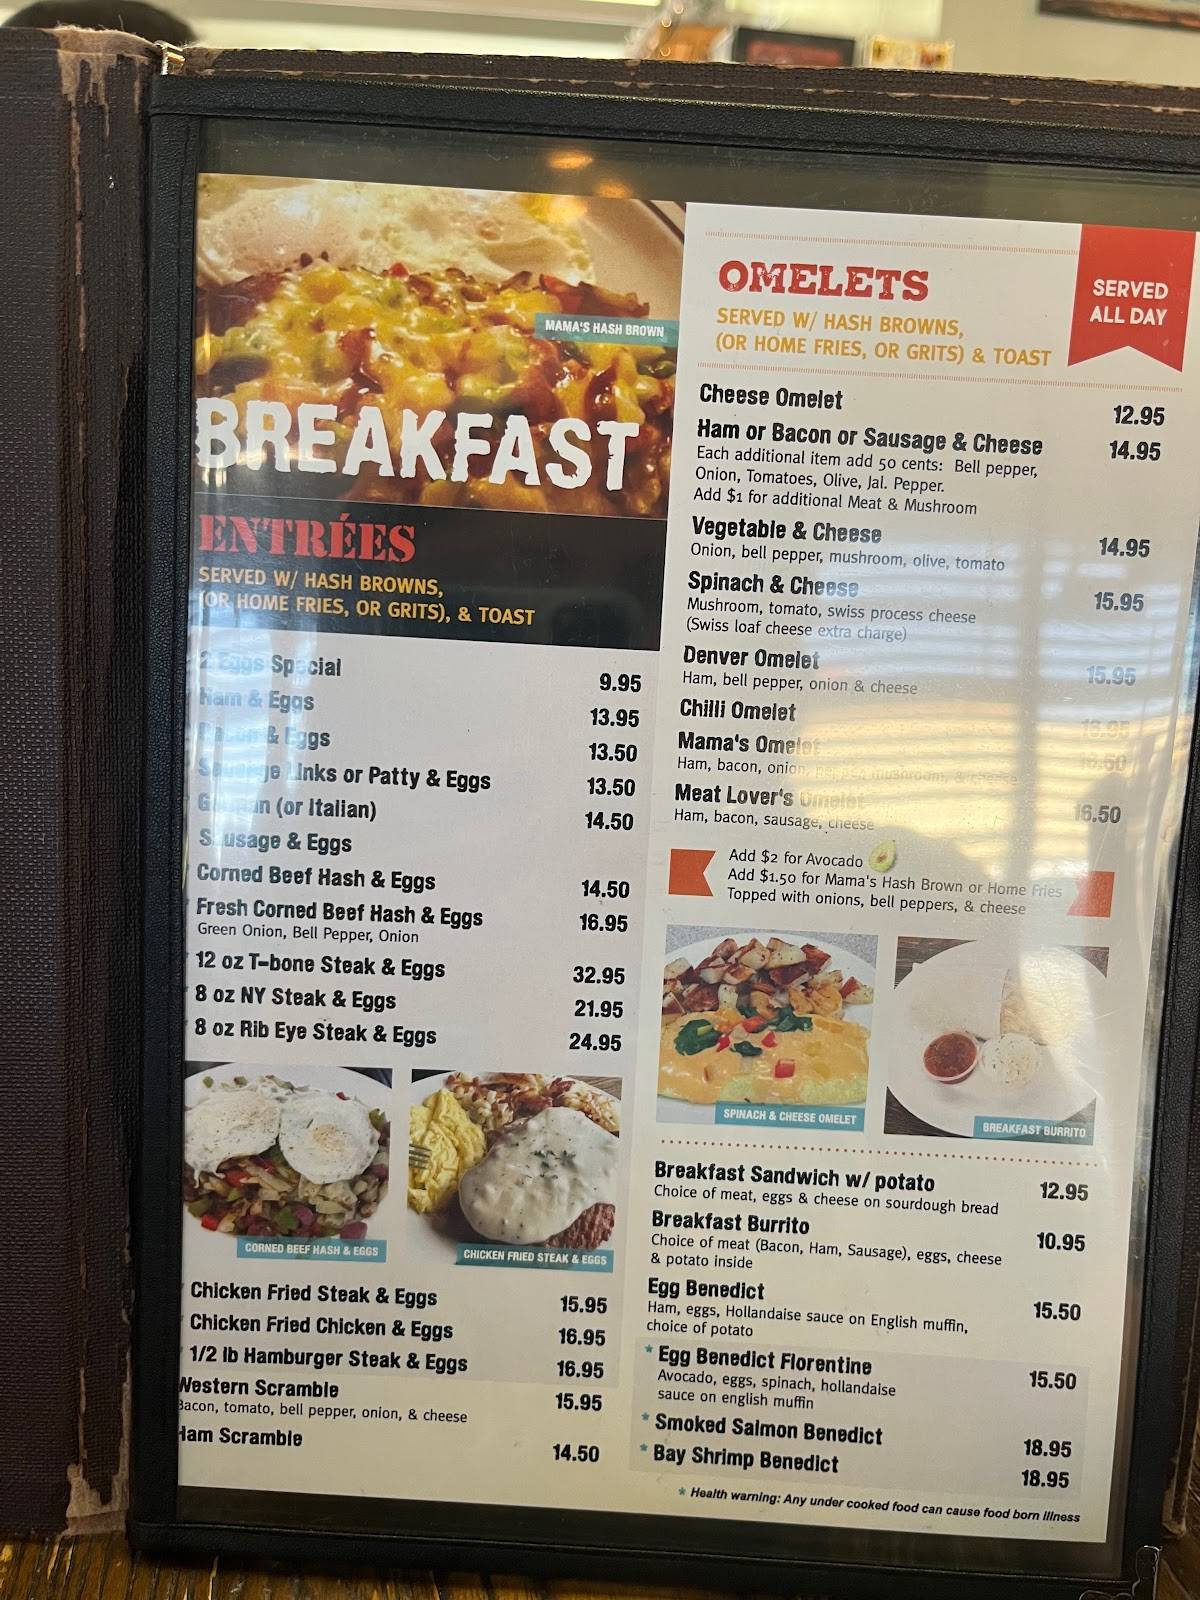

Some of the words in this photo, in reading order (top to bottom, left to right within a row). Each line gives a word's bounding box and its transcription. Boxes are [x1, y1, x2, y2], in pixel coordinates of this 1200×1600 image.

[719, 260, 928, 300] OMELETS
[1093, 279, 1168, 299] SERVED
[717, 307, 785, 328] SERVED
[793, 311, 817, 331] W/
[824, 313, 872, 331] HASH
[880, 316, 963, 339] BROWNS,
[1090, 305, 1124, 323] ALL
[1130, 307, 1167, 325] DAY
[545, 320, 590, 333] MAMA'S
[593, 322, 622, 334] HASH
[626, 324, 664, 337] BROWN
[716, 332, 746, 352] (OR
[754, 335, 806, 353] HOME
[814, 339, 866, 359] FRIES,
[874, 342, 899, 358] OR
[907, 344, 964, 365] GRITS)
[972, 348, 985, 363] &
[993, 348, 1052, 366] TOAST
[700, 383, 769, 405] Cheese
[776, 387, 842, 409] Omelet
[1113, 405, 1164, 425] 12.95
[195, 397, 639, 492] BREAKFAST
[697, 418, 739, 439] Ham
[746, 425, 766, 440] or
[772, 422, 831, 443] Bacon
[837, 430, 857, 445] or
[863, 427, 946, 453] Sausage
[952, 432, 967, 451] &
[973, 433, 1042, 455] Cheese
[1110, 440, 1160, 461] 14.95
[199, 512, 417, 563] ENTRÉES
[692, 516, 786, 540] Vegetable
[792, 521, 806, 539] &
[813, 522, 881, 542] Cheese
[1099, 537, 1149, 557] 14.95
[198, 567, 265, 584] SERVED
[274, 570, 297, 589] W/
[305, 572, 352, 589] HASH
[360, 575, 443, 598] BROWNS,
[600, 673, 641, 692] 9.95
[590, 708, 639, 727] 13.95
[680, 698, 725, 717] Chilli
[731, 701, 795, 721] Omelet
[589, 742, 637, 762] 13.50
[587, 777, 635, 796] 13.50
[585, 811, 633, 830] 14.50
[729, 848, 755, 861] Add
[761, 849, 777, 864] $2
[784, 851, 802, 864] for
[806, 852, 862, 867] Avocado
[197, 863, 262, 882] Corned
[269, 866, 312, 884] Beef
[318, 868, 364, 887] Hash
[371, 870, 385, 887] &
[391, 871, 435, 893] Eggs
[582, 880, 629, 898] 14.50
[196, 897, 247, 916] Fresh
[253, 900, 316, 918] Corned
[323, 902, 364, 921] Beef
[370, 904, 415, 923] Hash
[421, 906, 434, 924] &
[440, 907, 482, 929] Eggs
[579, 913, 627, 932] 16.95
[198, 922, 236, 935] Green
[242, 924, 286, 939] Onion,
[293, 926, 317, 938] Bell
[323, 927, 372, 943] Pepper,
[379, 929, 418, 942] Onion
[195, 951, 215, 968] 12
[222, 955, 243, 969] oz
[248, 953, 314, 972] T-bone
[320, 956, 375, 974] Steak
[381, 958, 395, 975] &
[401, 959, 444, 981] Eggs
[573, 966, 624, 984] 32.95
[195, 1018, 206, 1035] 8
[213, 1022, 234, 1036] oz
[240, 1020, 269, 1037] Rib
[275, 1021, 306, 1042] Eye
[312, 1023, 367, 1041] Steak
[373, 1025, 387, 1042] &
[393, 1026, 436, 1047] Eggs
[569, 1033, 621, 1051] 24.95
[723, 1108, 766, 1119] SPINACH
[769, 1111, 776, 1120] &
[779, 1111, 816, 1122] CHEESE
[818, 1113, 856, 1124] OMELET
[983, 1122, 1042, 1134] BREAKFAST
[1044, 1125, 1085, 1137] BURRITO
[655, 1161, 745, 1181] Breakfast
[750, 1165, 839, 1186] Sandwich
[845, 1171, 870, 1187] w/
[875, 1173, 934, 1192] potato
[1040, 1182, 1088, 1201] 12.95
[652, 1210, 741, 1230] Breakfast
[748, 1215, 809, 1234] Burrito
[245, 1243, 283, 1253] CORNED
[287, 1244, 310, 1254] BEEF
[312, 1245, 340, 1255] HASH
[343, 1246, 350, 1255] &
[353, 1246, 378, 1256] EGGS
[1037, 1232, 1085, 1251] 10.95
[463, 1249, 504, 1260] CHICKEN
[507, 1251, 534, 1261] FRIED
[537, 1253, 568, 1263] STEAK
[572, 1254, 579, 1263] &
[582, 1255, 606, 1264] EGGS
[651, 1252, 660, 1263] &
[666, 1254, 708, 1267] potato
[714, 1255, 752, 1268] inside
[648, 1277, 679, 1298] Egg
[686, 1279, 764, 1300] Benedict
[561, 1296, 607, 1313] 15.95
[1033, 1301, 1080, 1320] 15.50
[559, 1328, 605, 1346] 16.95
[647, 1319, 687, 1332] choice
[693, 1321, 707, 1333] of
[711, 1324, 753, 1337] potato
[190, 1345, 217, 1361] 1/2
[223, 1346, 238, 1362] lb
[244, 1347, 343, 1369] Hamburger
[348, 1350, 400, 1368] Steak
[406, 1352, 419, 1369] &
[426, 1353, 467, 1374] Eggs
[557, 1360, 603, 1378] 16.95
[659, 1345, 690, 1367] Egg
[697, 1347, 775, 1368] Benedict
[780, 1353, 871, 1375] Florentine
[1029, 1370, 1076, 1389] 15.50
[555, 1393, 601, 1411] 15.95
[655, 1413, 726, 1433] Smoked
[732, 1418, 797, 1438] Salmon
[804, 1423, 882, 1445] Benedict
[553, 1444, 599, 1462] 14.50
[1024, 1439, 1071, 1457] 18.95
[654, 1444, 686, 1465] Bay
[692, 1446, 754, 1470] Shrimp
[760, 1451, 838, 1473] Benedict
[1021, 1469, 1069, 1488] 18.95
[690, 1487, 727, 1499] Health
[731, 1492, 780, 1505] warning:
[783, 1494, 807, 1507] Any
[810, 1497, 844, 1507] under
[846, 1500, 889, 1510] cooked
[892, 1501, 919, 1512] food
[922, 1506, 942, 1514] can
[946, 1507, 980, 1516] cause
[983, 1507, 1010, 1518] food
[1012, 1509, 1039, 1520] born
[1043, 1511, 1080, 1522] Illness
